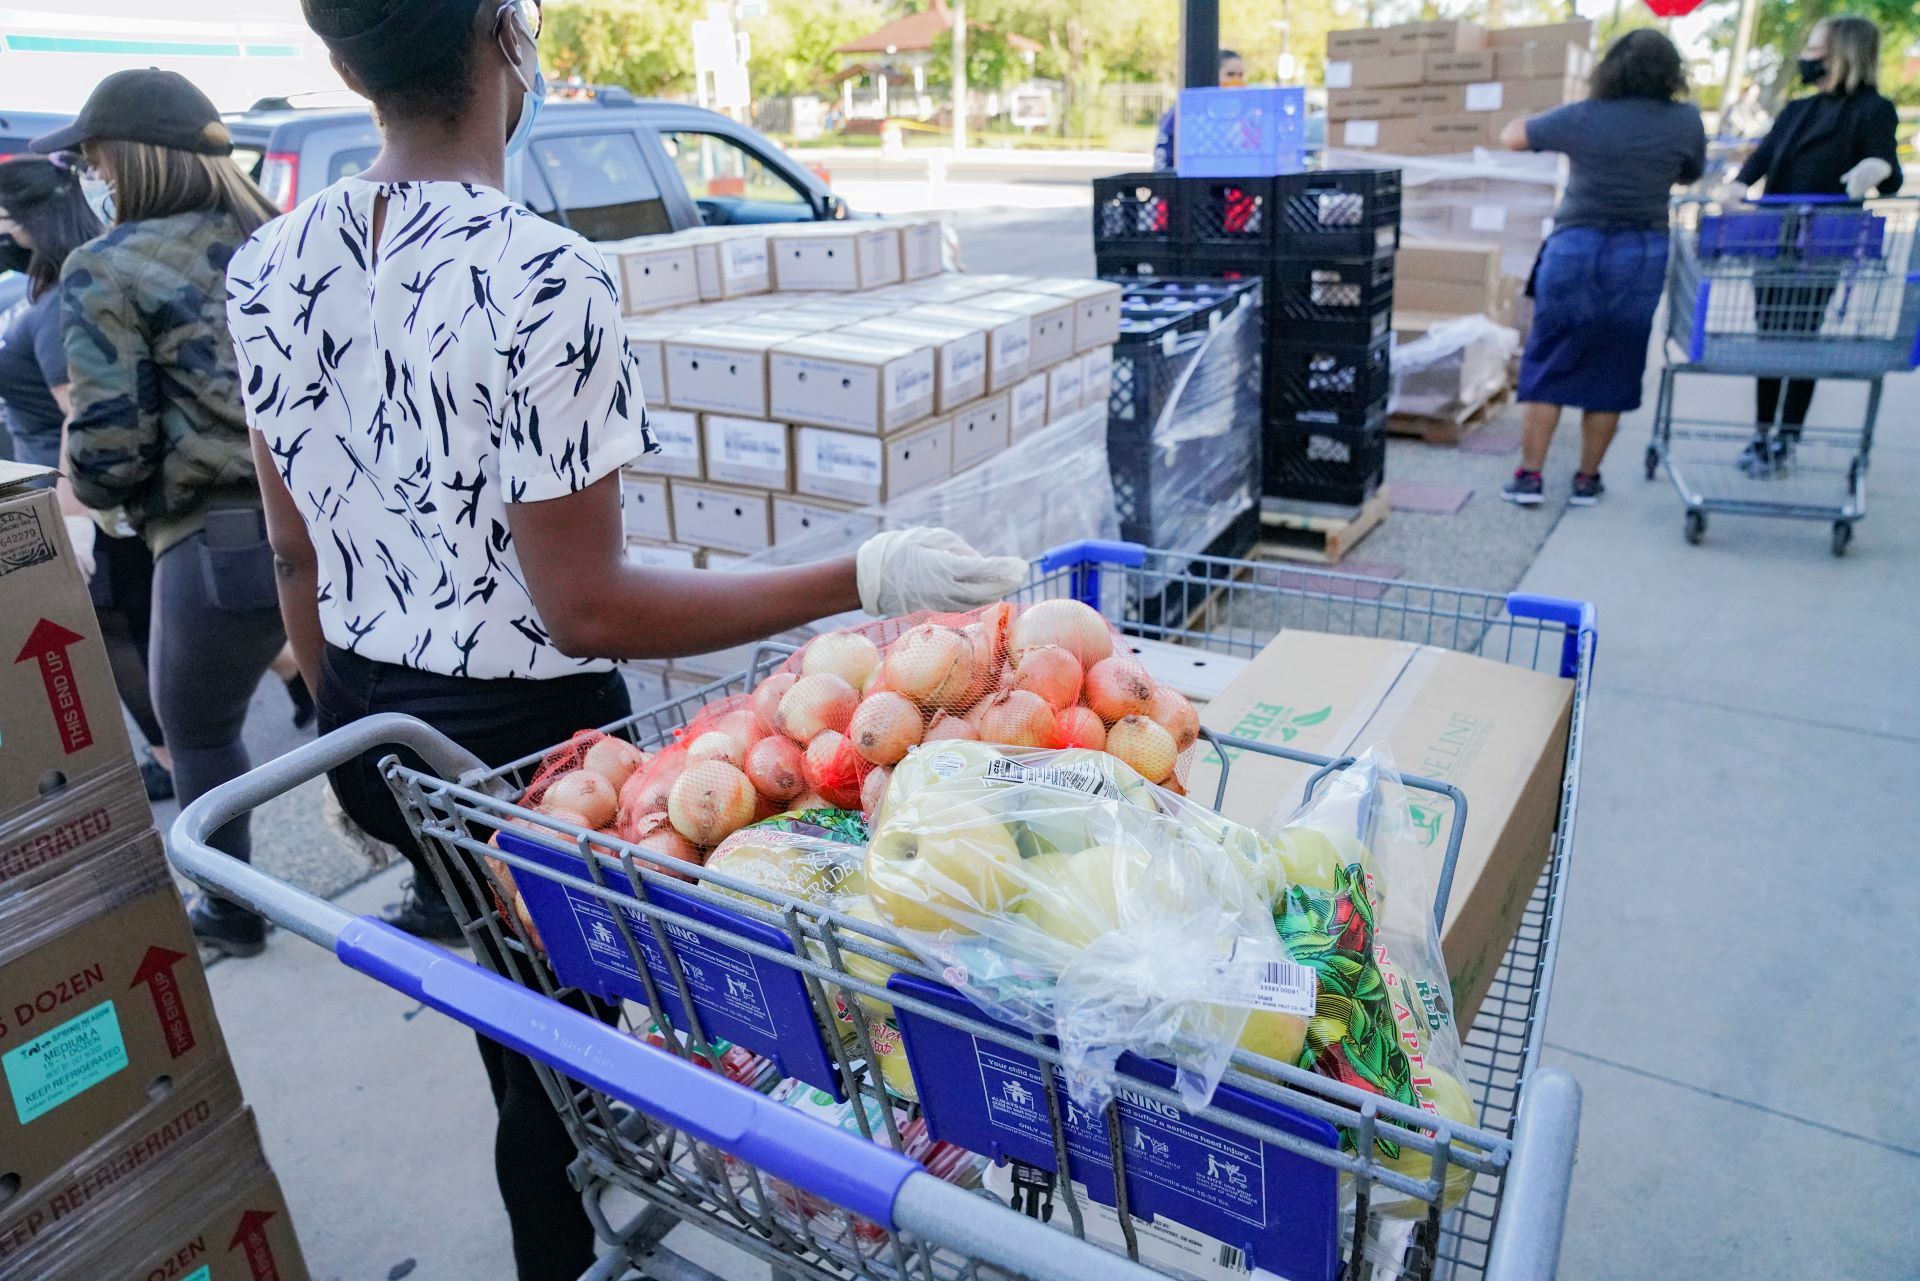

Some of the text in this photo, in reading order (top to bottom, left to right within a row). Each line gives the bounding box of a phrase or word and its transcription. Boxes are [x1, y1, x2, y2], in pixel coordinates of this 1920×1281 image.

[46, 649, 84, 748] THIS END UP
[1201, 702, 1285, 767] FREH
[627, 909, 699, 944] WANING
[1365, 871, 1399, 988] ENS
[16, 964, 104, 1026] DOZEN
[1415, 979, 1441, 1032] RED
[24, 1084, 52, 1104] KEEP
[52, 1046, 122, 1089] REFRIGERATED
[43, 1033, 89, 1062] MEDIUM
[89, 1027, 98, 1037] A
[986, 1058, 1009, 1070] Your
[1008, 1066, 1028, 1077] child
[1131, 1111, 1158, 1125] suffer
[1165, 1124, 1199, 1140] serious
[1199, 1135, 1223, 1149] head
[1117, 1089, 1181, 1121] NING
[48, 1100, 210, 1221] REFRIGERATED
[1018, 1122, 1039, 1133] ONLY
[1154, 1174, 1181, 1188] months
[1181, 1184, 1195, 1193] and
[1206, 1176, 1223, 1186] NOT
[1222, 1183, 1236, 1191] use
